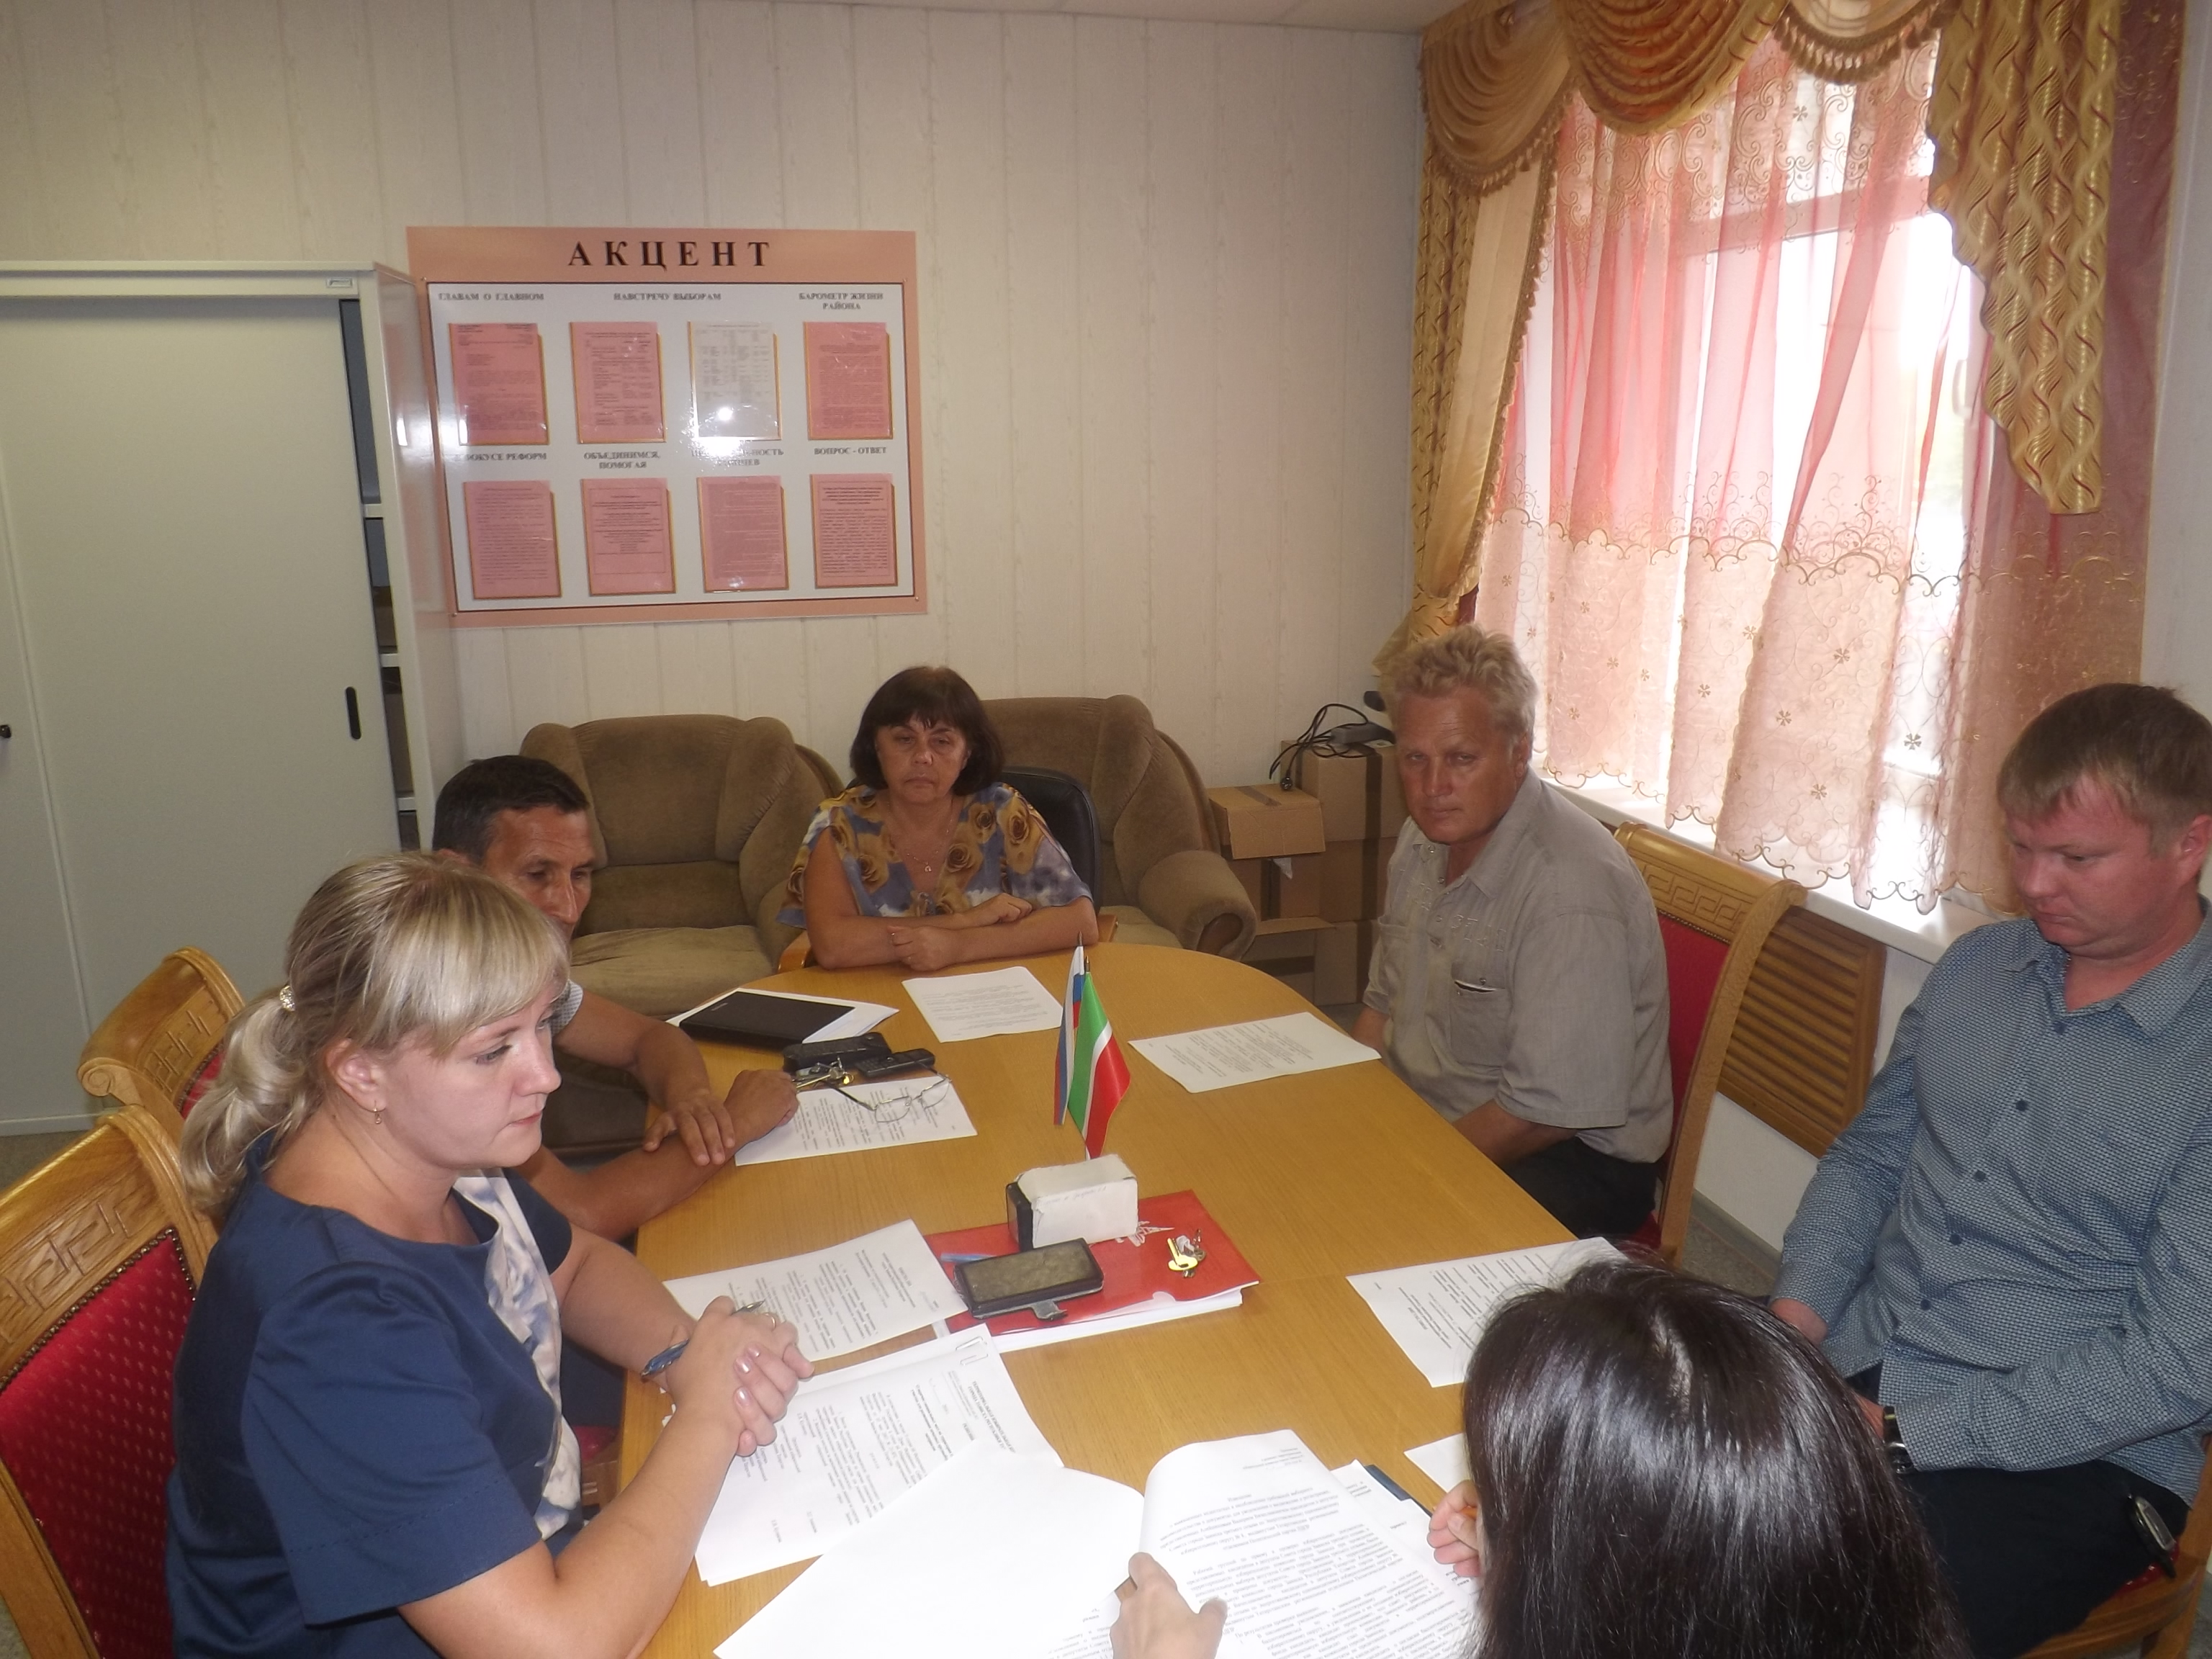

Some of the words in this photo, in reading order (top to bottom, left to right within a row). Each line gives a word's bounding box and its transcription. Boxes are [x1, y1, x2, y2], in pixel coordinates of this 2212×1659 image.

[568, 240, 770, 271] АКЦЕНТ
[613, 292, 670, 301] НАВСТРЕЧУ
[673, 292, 722, 301] ВЫБОРАМ
[505, 452, 547, 461] РЕФОРМ
